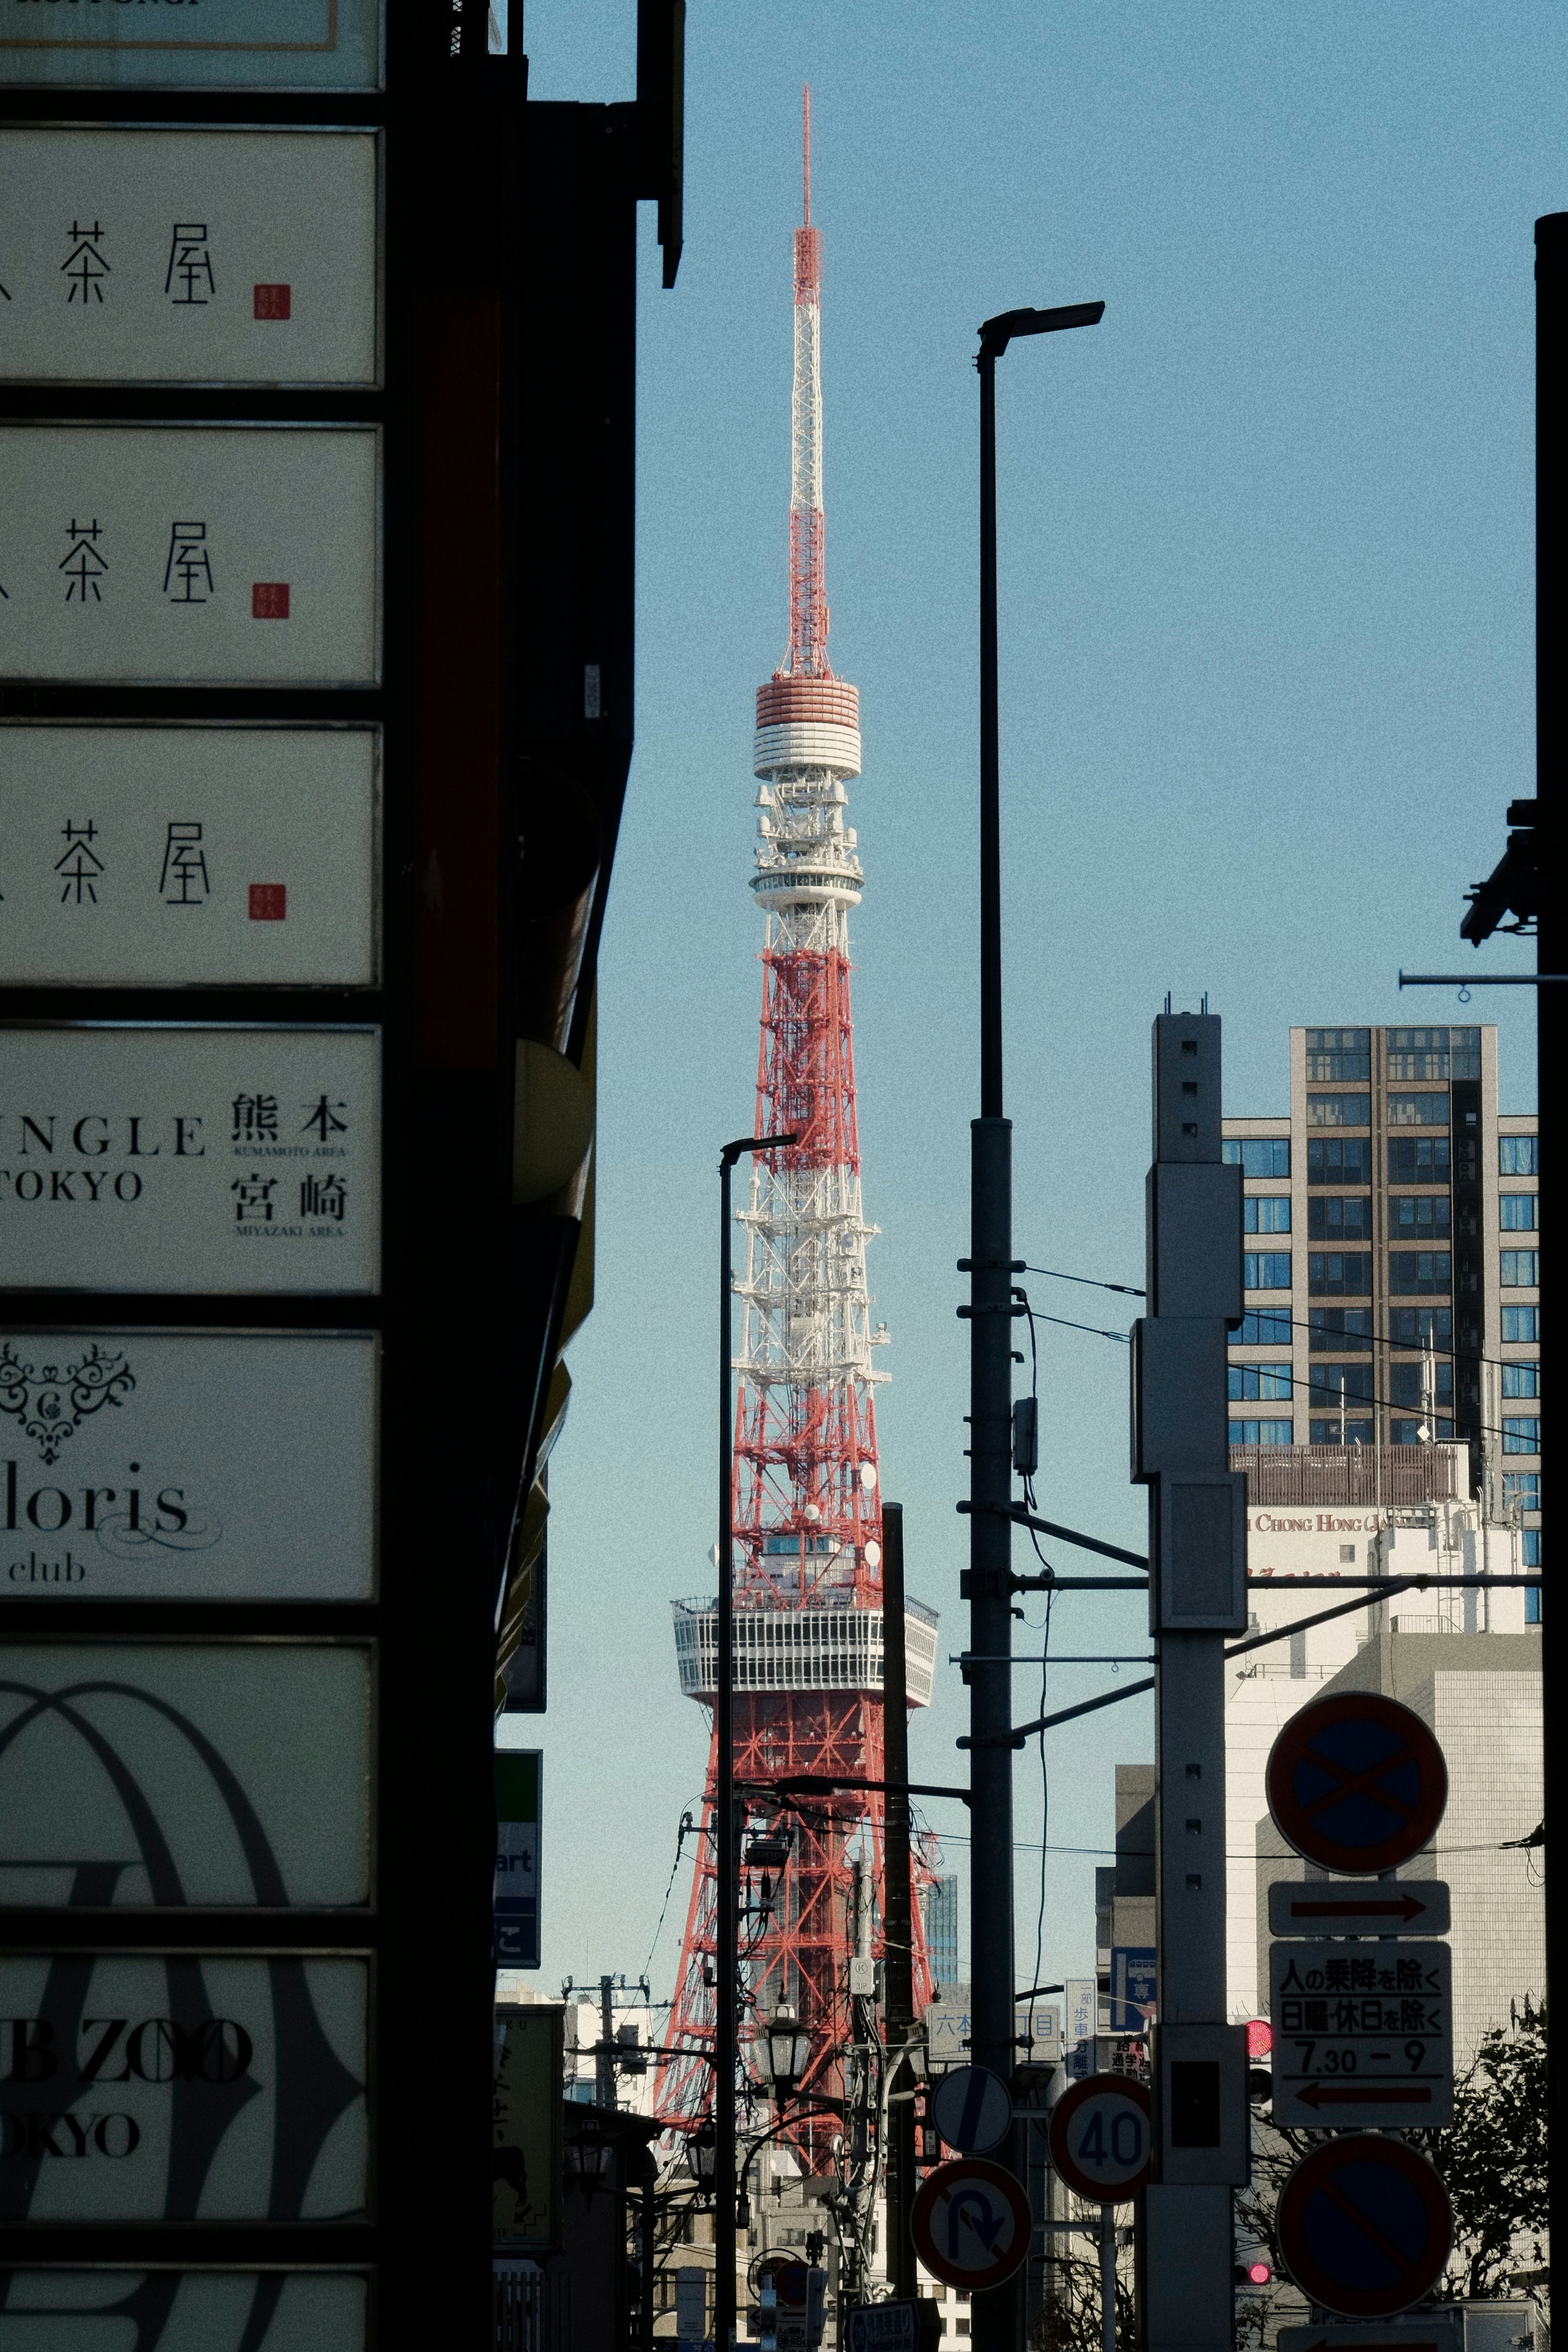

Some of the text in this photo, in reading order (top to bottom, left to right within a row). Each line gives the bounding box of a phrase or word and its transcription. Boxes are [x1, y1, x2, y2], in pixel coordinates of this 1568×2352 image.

[0, 221, 214, 304] 茶屋
[0, 519, 213, 602] 茶屋
[0, 820, 209, 903] 茶屋
[0, 1115, 206, 1156] NGLE
[232, 1093, 348, 1141] 熊本
[231, 1174, 348, 1221] 宮崎
[9, 1552, 86, 1583] club
[1280, 1958, 1441, 1993] 人の乗降を除く
[0, 2018, 57, 2082] B
[1078, 2110, 1142, 2168] 40
